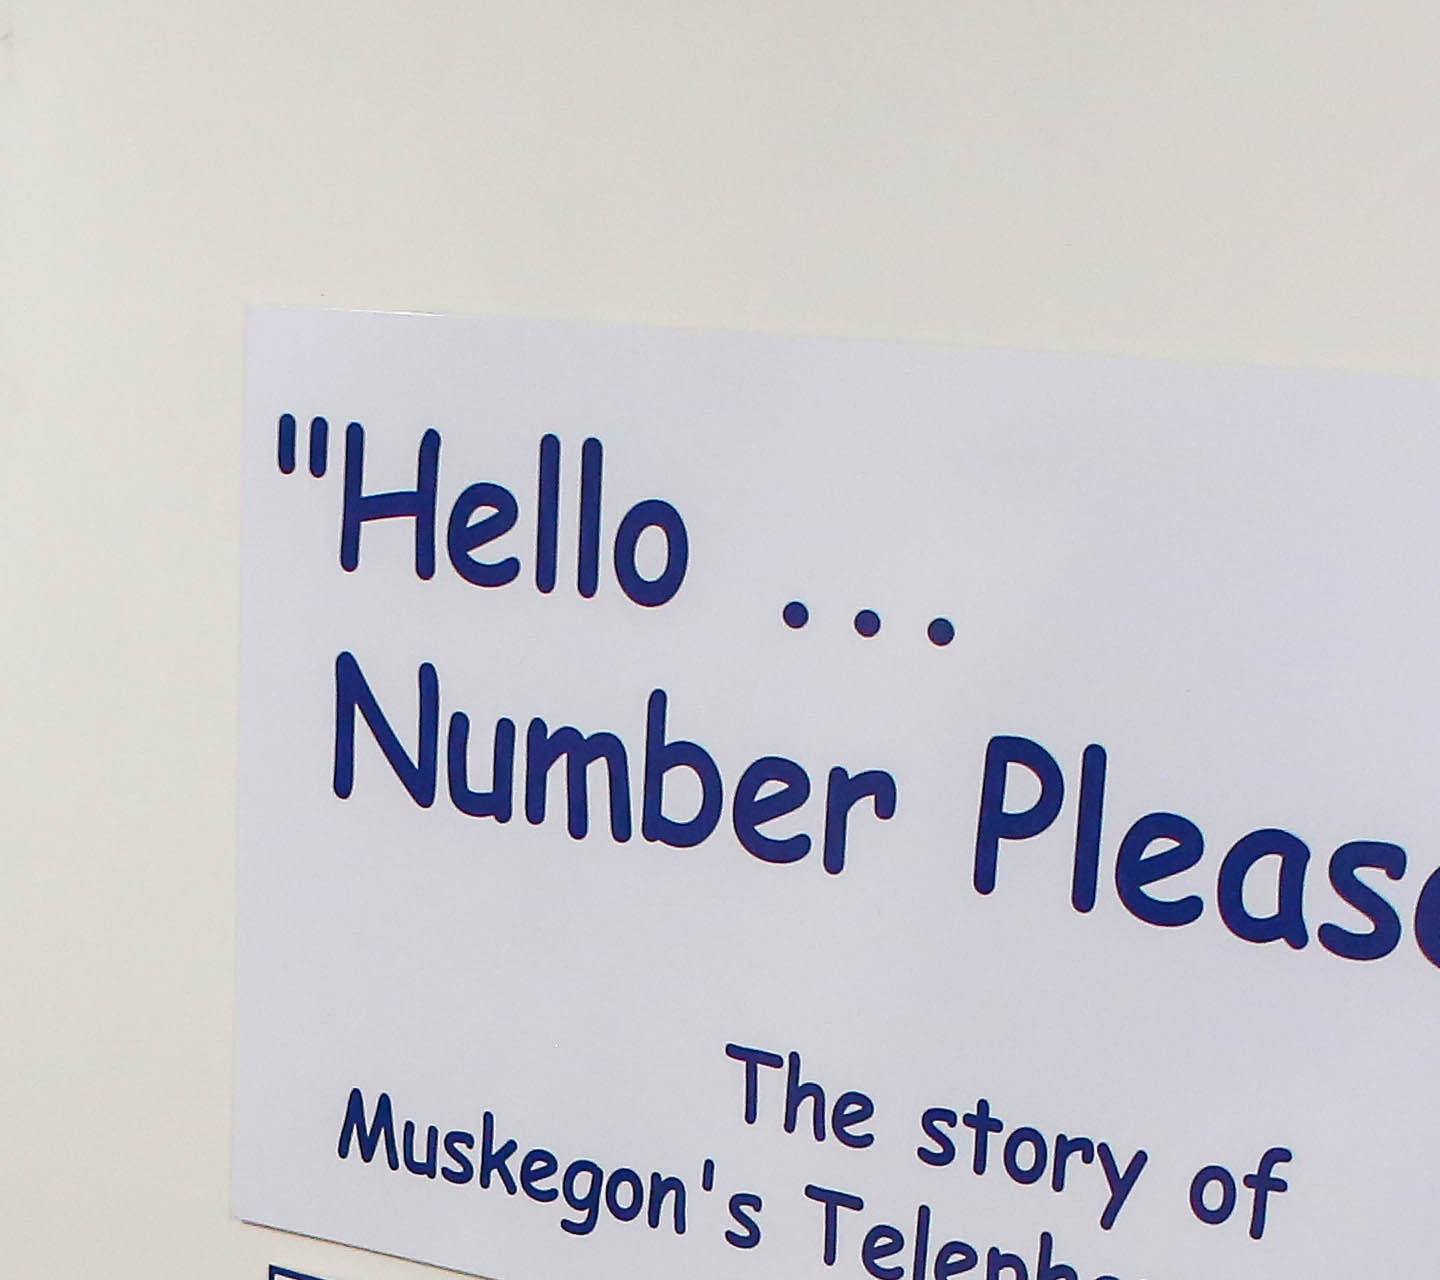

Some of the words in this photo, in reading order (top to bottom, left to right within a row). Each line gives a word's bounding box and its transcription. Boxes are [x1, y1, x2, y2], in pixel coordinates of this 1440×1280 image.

[280, 413, 688, 603] "Hello
[336, 651, 896, 872] Number
[341, 1088, 761, 1246] Muskegon's
[728, 1043, 874, 1145] The
[920, 1099, 1148, 1227] story
[1192, 1147, 1292, 1235] of
